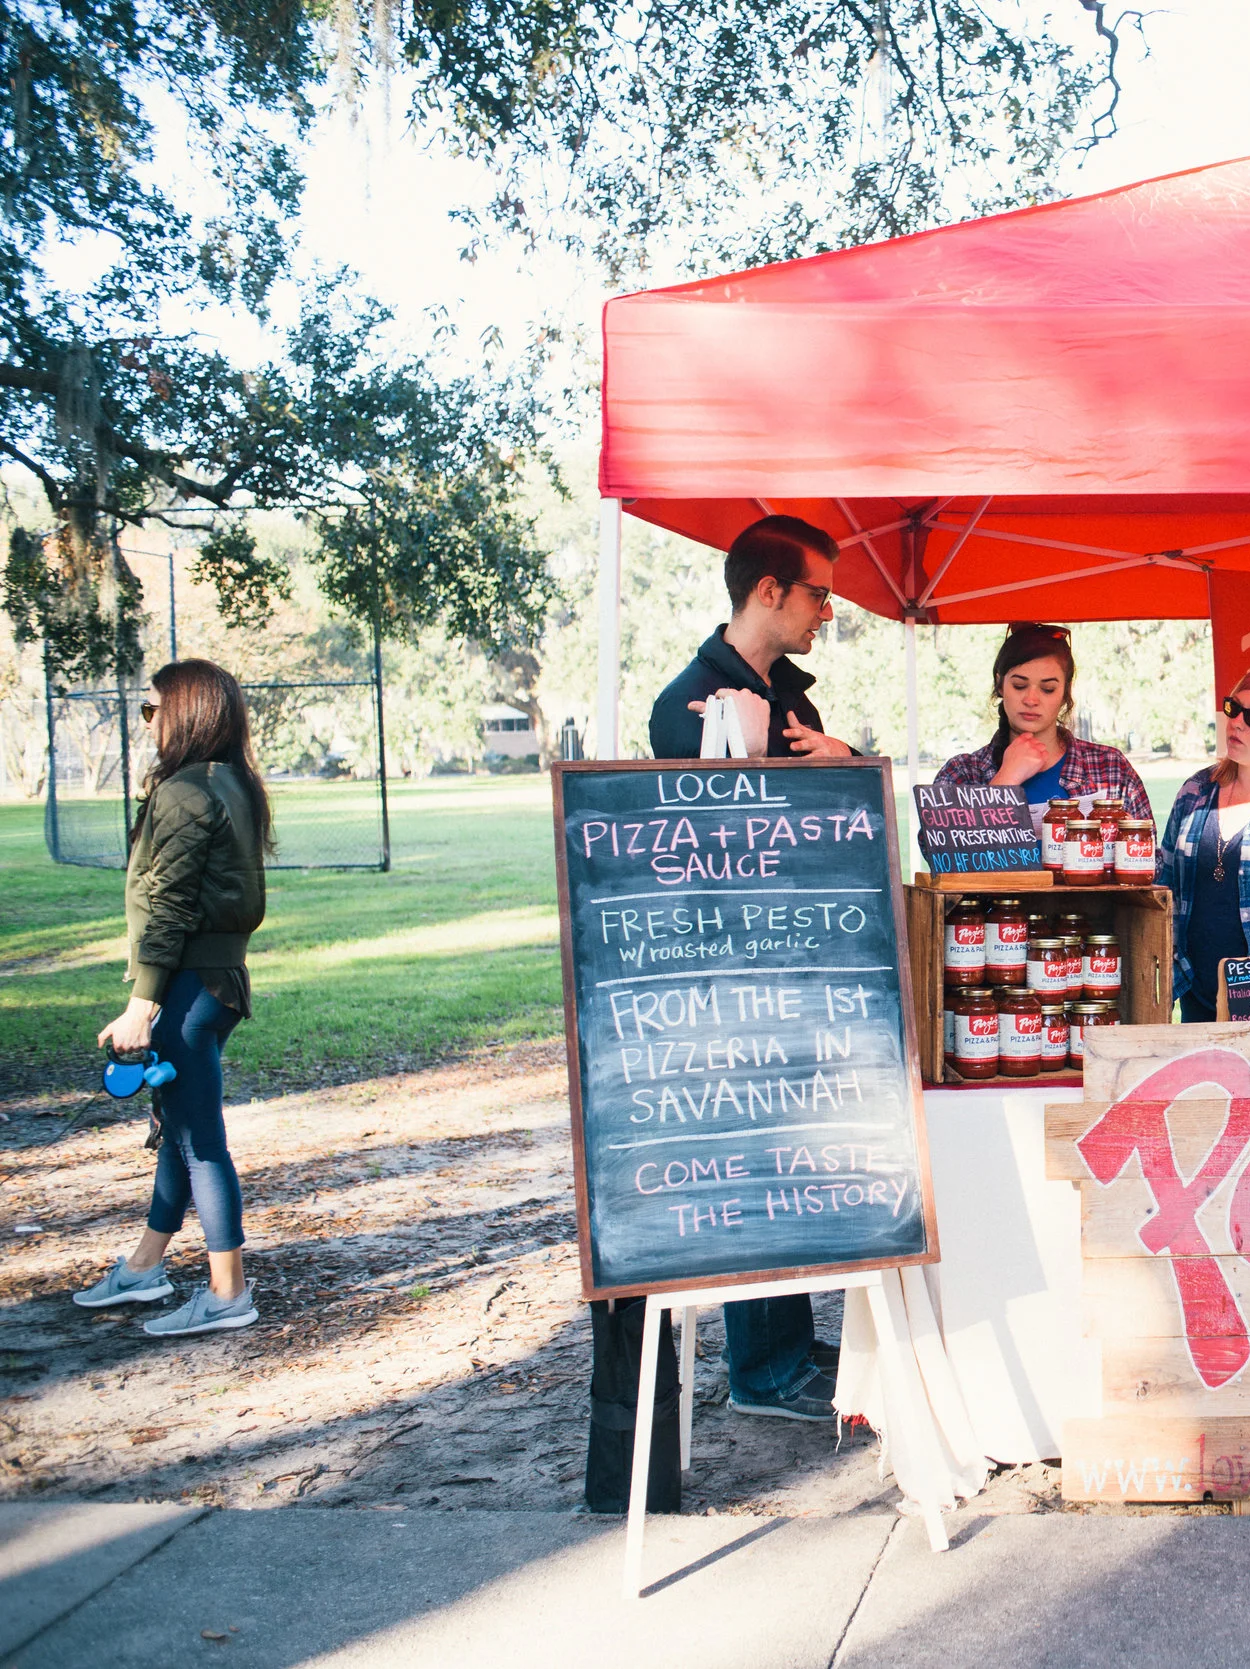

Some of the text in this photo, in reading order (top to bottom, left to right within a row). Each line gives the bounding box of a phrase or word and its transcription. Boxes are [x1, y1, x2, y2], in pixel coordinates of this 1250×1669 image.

[657, 773, 787, 804] LOCAL
[920, 787, 1025, 808] ALL NATURAL
[582, 816, 699, 858] PIZZA
[746, 810, 874, 849] PASTA
[921, 807, 1019, 828] GLUTEN FREE
[926, 829, 946, 847] NO
[950, 828, 1037, 847] PRESERVATIVES
[651, 850, 781, 885] SAUCE
[932, 847, 1041, 873] NO HF CORN SYRUP
[600, 902, 866, 944] FRESH PESTO
[745, 934, 820, 959] garlic
[609, 984, 722, 1040] FROM
[729, 984, 802, 1022] THE
[621, 1026, 852, 1084] PIZZERIA IN
[630, 1069, 863, 1123] SAVANNAH
[635, 1144, 888, 1195] COME TASTE
[669, 1178, 908, 1237] THE HISTORY
